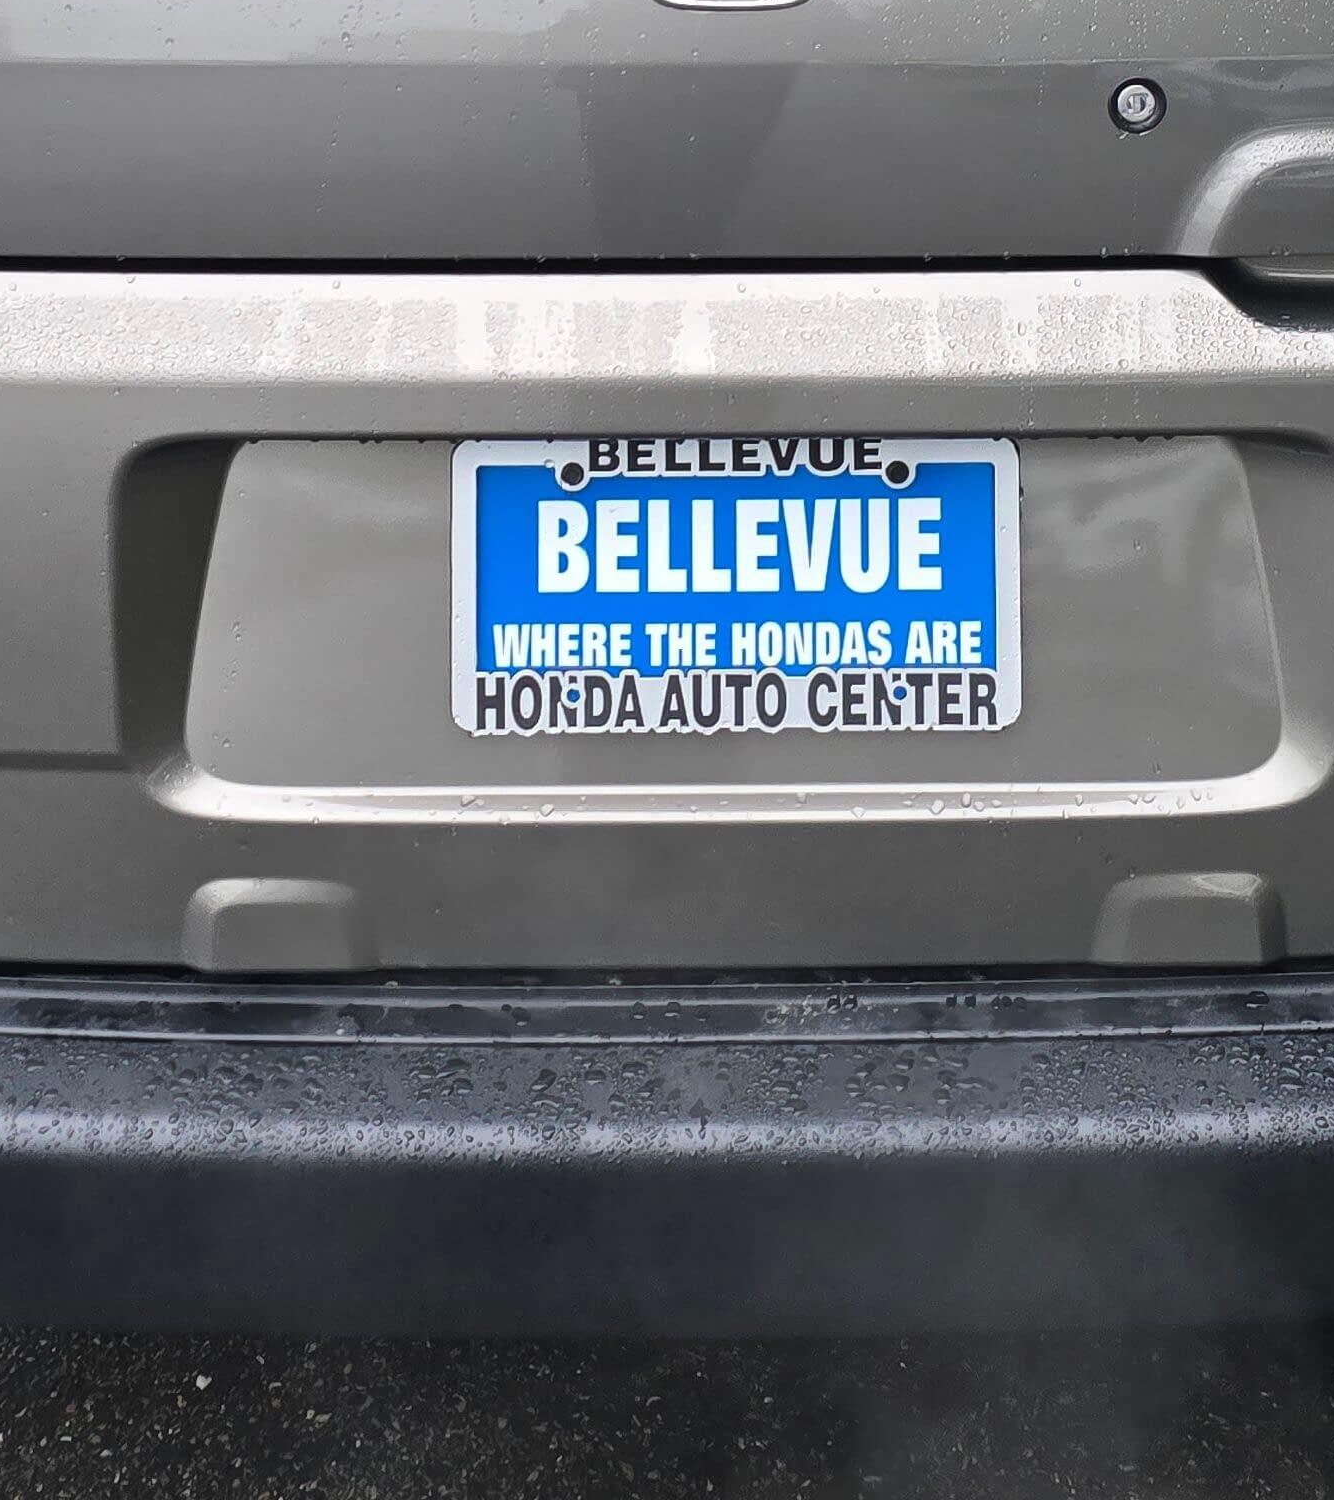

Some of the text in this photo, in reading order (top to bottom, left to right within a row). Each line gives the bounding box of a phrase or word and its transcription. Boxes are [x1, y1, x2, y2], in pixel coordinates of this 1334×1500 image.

[588, 438, 883, 472] BELLEVUE
[537, 497, 942, 593] BELLEVUE
[492, 620, 982, 667] WHERE THE HONDAS ARE
[476, 672, 998, 730] HONDA AUTO CENTER
